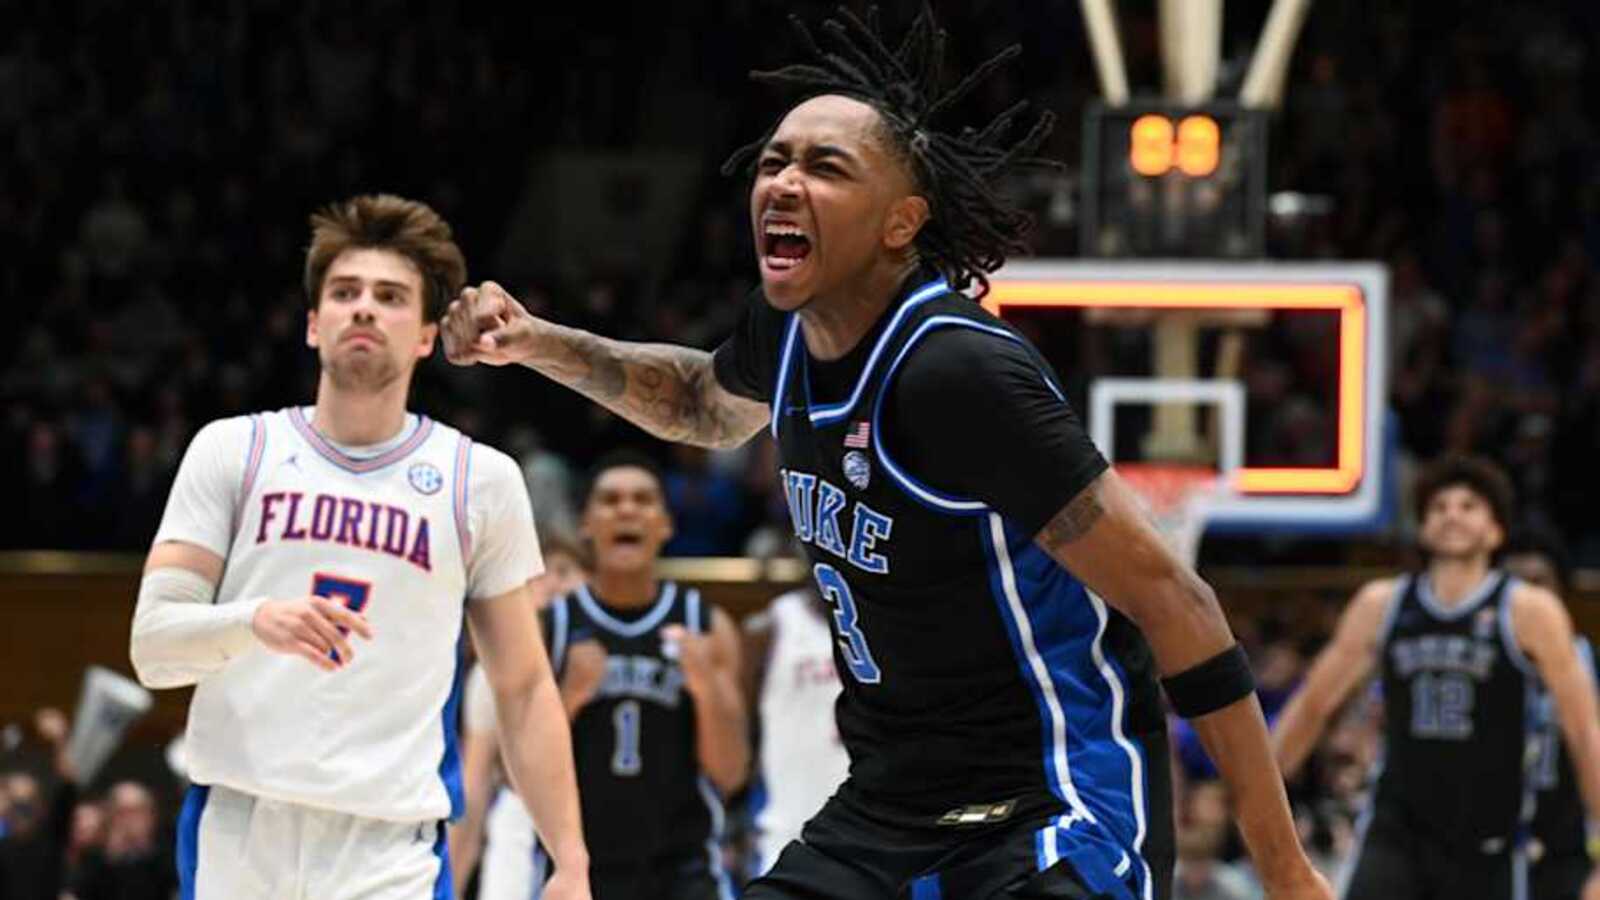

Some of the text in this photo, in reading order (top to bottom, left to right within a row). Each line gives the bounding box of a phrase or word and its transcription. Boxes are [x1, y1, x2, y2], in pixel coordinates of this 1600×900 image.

[255, 491, 433, 573] FLORIDA
[779, 468, 893, 574] UKE
[813, 562, 882, 685] 3
[611, 700, 642, 776] 1
[1410, 673, 1475, 740] 12
